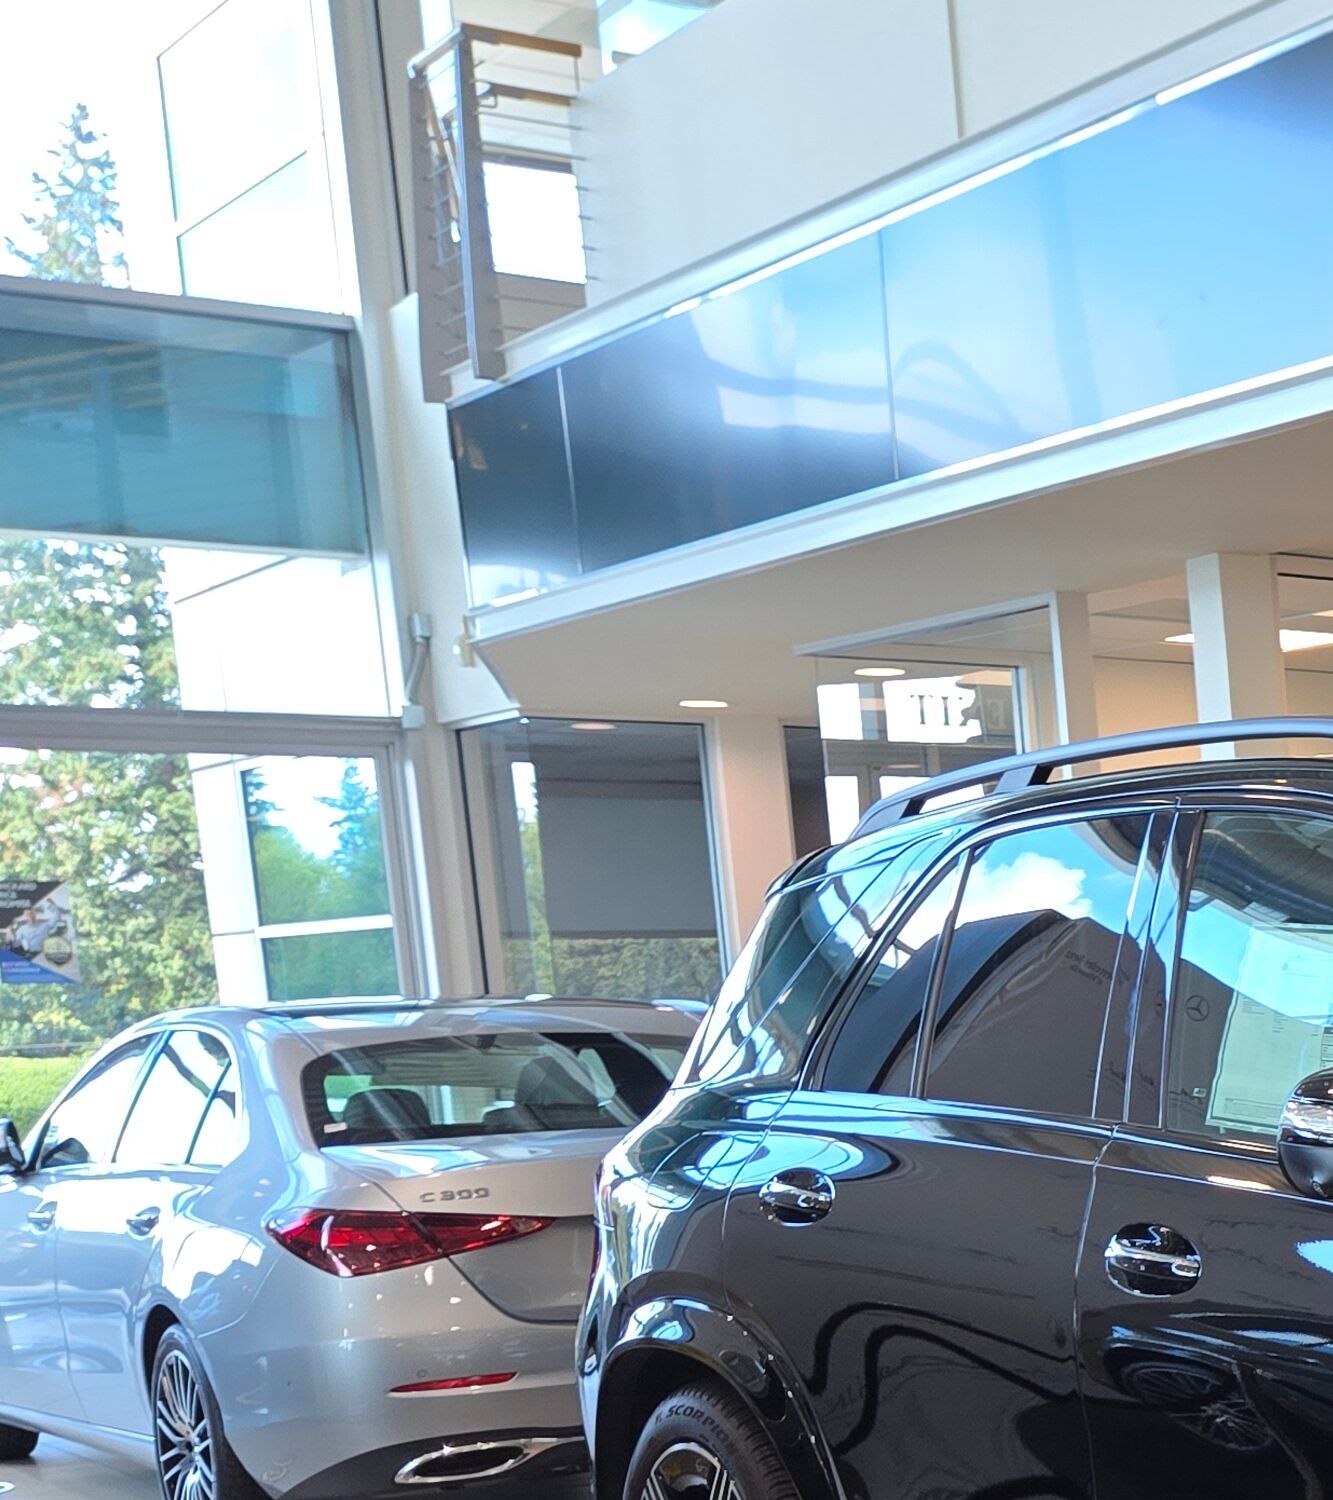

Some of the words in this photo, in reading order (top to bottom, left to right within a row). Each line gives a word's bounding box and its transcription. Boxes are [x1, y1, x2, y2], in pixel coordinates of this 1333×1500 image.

[419, 1192, 436, 1203] C
[440, 1187, 490, 1201] 300
[665, 1403, 738, 1455] SCORPION
